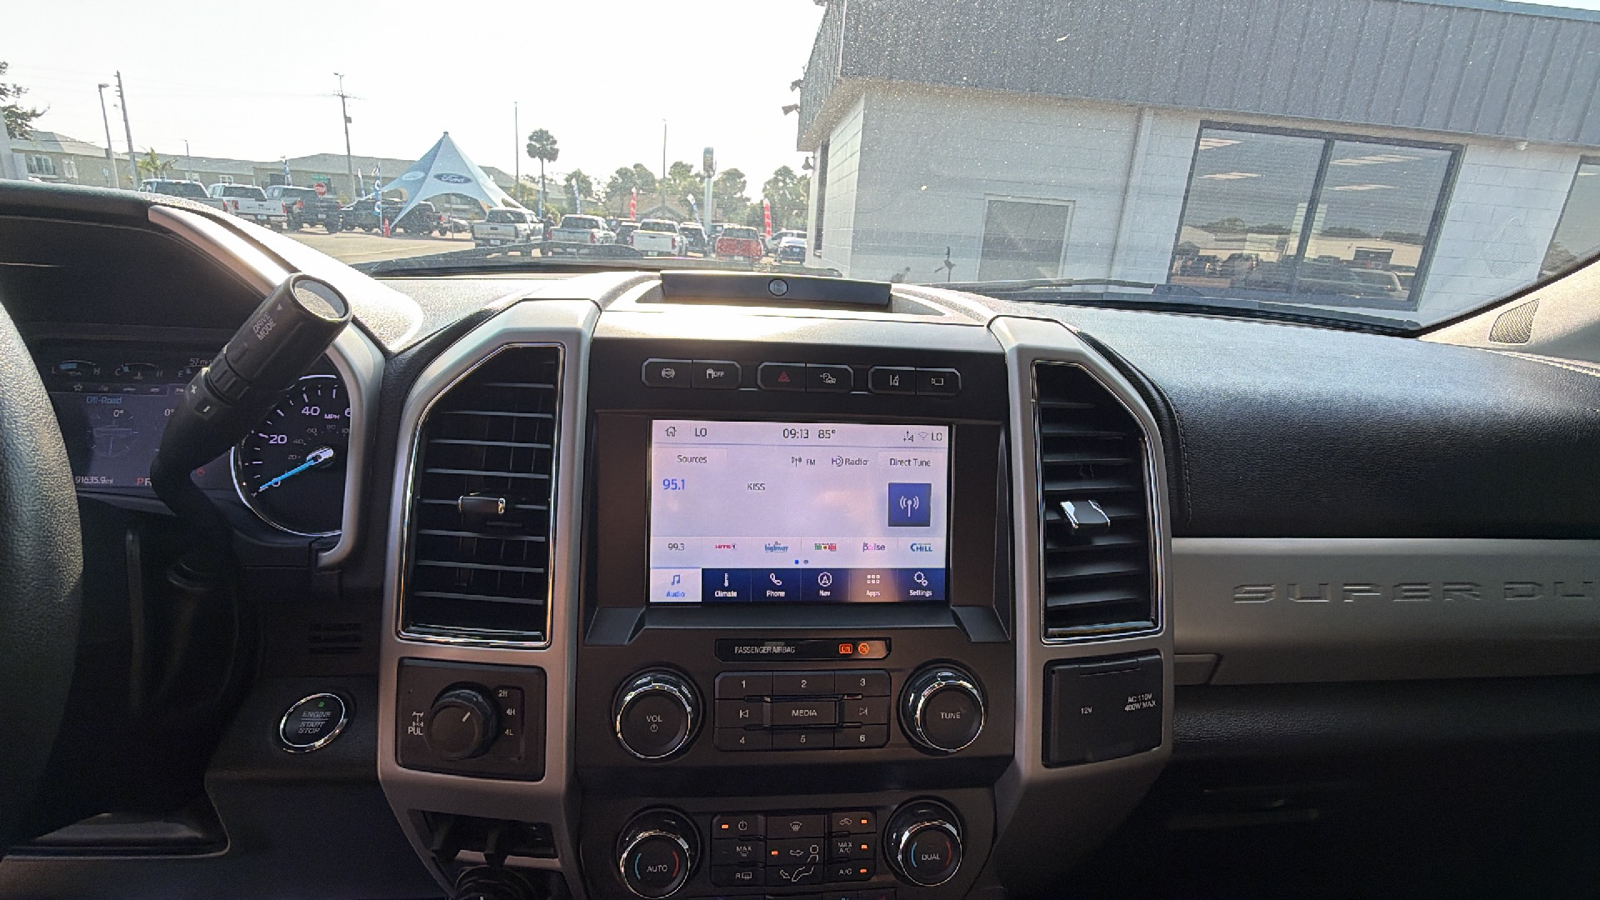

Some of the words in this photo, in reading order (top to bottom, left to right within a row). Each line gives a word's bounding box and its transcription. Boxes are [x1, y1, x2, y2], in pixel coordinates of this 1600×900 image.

[257, 319, 277, 340] MODE
[301, 406, 320, 416] 40
[694, 427, 708, 438] LO
[782, 428, 810, 439] 09:13
[818, 428, 836, 439] 85°
[931, 432, 943, 442] LO
[268, 434, 288, 444] 20
[677, 453, 708, 464] Sources
[806, 458, 816, 466] FM
[844, 457, 869, 466] Radio
[889, 457, 911, 467] Direct
[913, 457, 931, 467] Tune
[662, 478, 686, 491] 95.1
[747, 482, 766, 491] KISS
[667, 542, 685, 551] 99.3
[666, 590, 686, 598] Audio
[714, 590, 738, 598] Climate
[766, 590, 786, 598] Phone
[819, 590, 831, 598] Nav
[865, 590, 881, 599] Apps
[909, 589, 933, 599] Settings
[1233, 580, 1483, 604] SUPER
[734, 646, 772, 654] PASSENGER
[772, 646, 796, 654] AIRBAG
[741, 680, 747, 688] 1
[801, 679, 807, 688] 2
[859, 678, 866, 687] 3
[498, 689, 508, 698] 2H
[1127, 695, 1137, 704] AC
[1138, 692, 1153, 702] 110V
[1142, 699, 1157, 709] MAX
[506, 707, 516, 716] 4H
[791, 708, 818, 717] MEDIA
[1081, 706, 1093, 715] 12V
[646, 714, 663, 723] VOL
[940, 711, 961, 720] TUNE
[504, 728, 514, 736] 4L
[739, 735, 746, 744] 4
[800, 735, 806, 744] 5
[859, 734, 866, 743] 6
[921, 853, 941, 861] DUAL
[647, 864, 668, 873] AUTO
